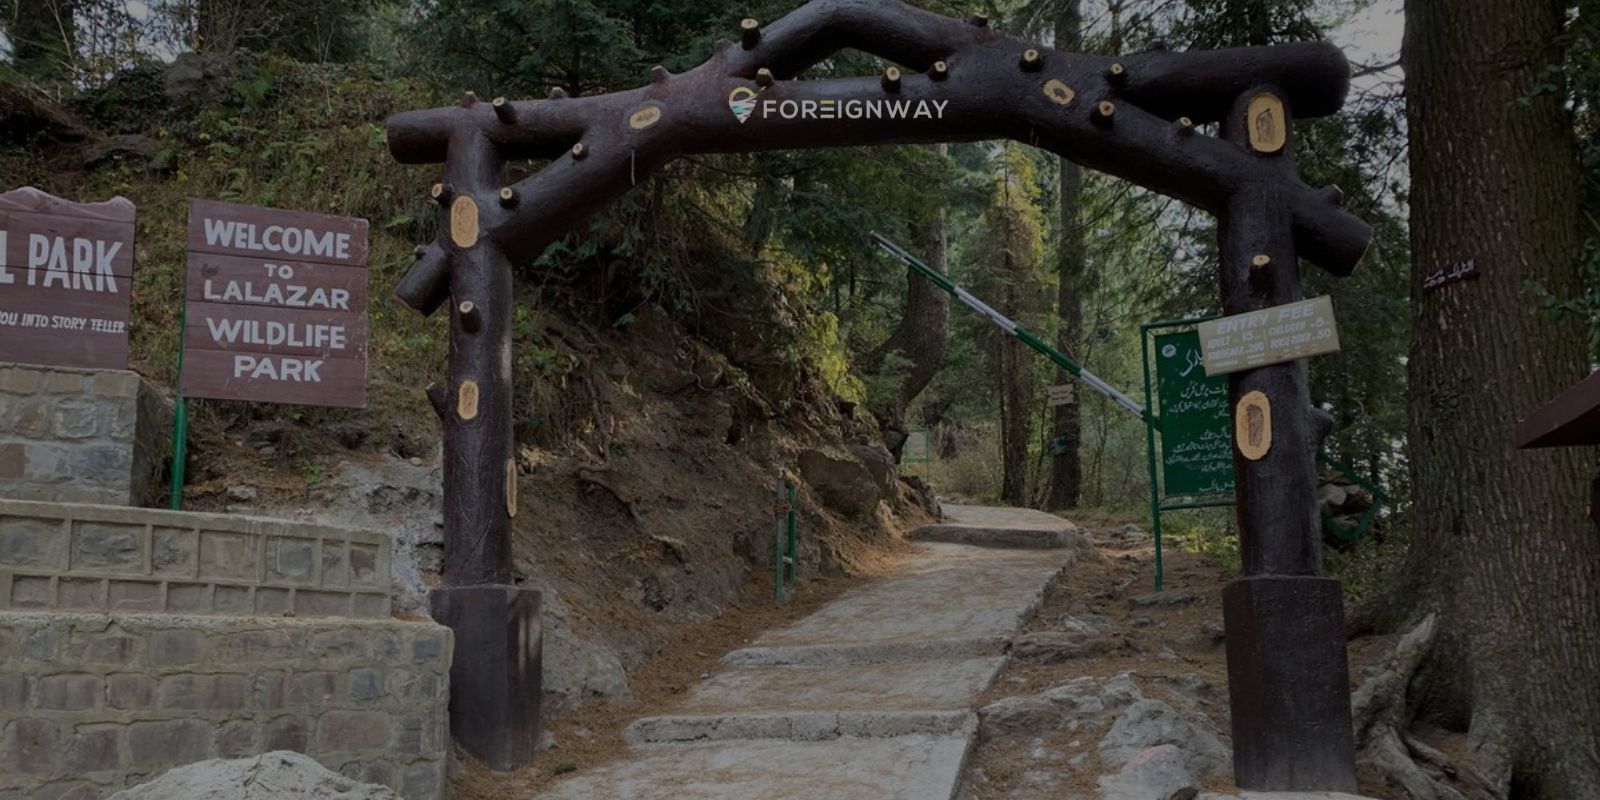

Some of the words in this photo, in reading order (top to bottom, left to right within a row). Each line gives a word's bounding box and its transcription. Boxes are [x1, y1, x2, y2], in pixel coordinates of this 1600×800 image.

[204, 218, 350, 259] WELCOME
[27, 233, 124, 293] PARK
[264, 263, 294, 280] TO
[203, 279, 350, 310] LALAZAR
[21, 313, 48, 328] INTO
[51, 315, 87, 330] STORY
[91, 318, 125, 333] TELLER
[205, 317, 345, 349] WILDLIFE
[1216, 312, 1270, 335] ENTRY
[1278, 303, 1314, 323] FEE
[234, 355, 324, 382] PARK
